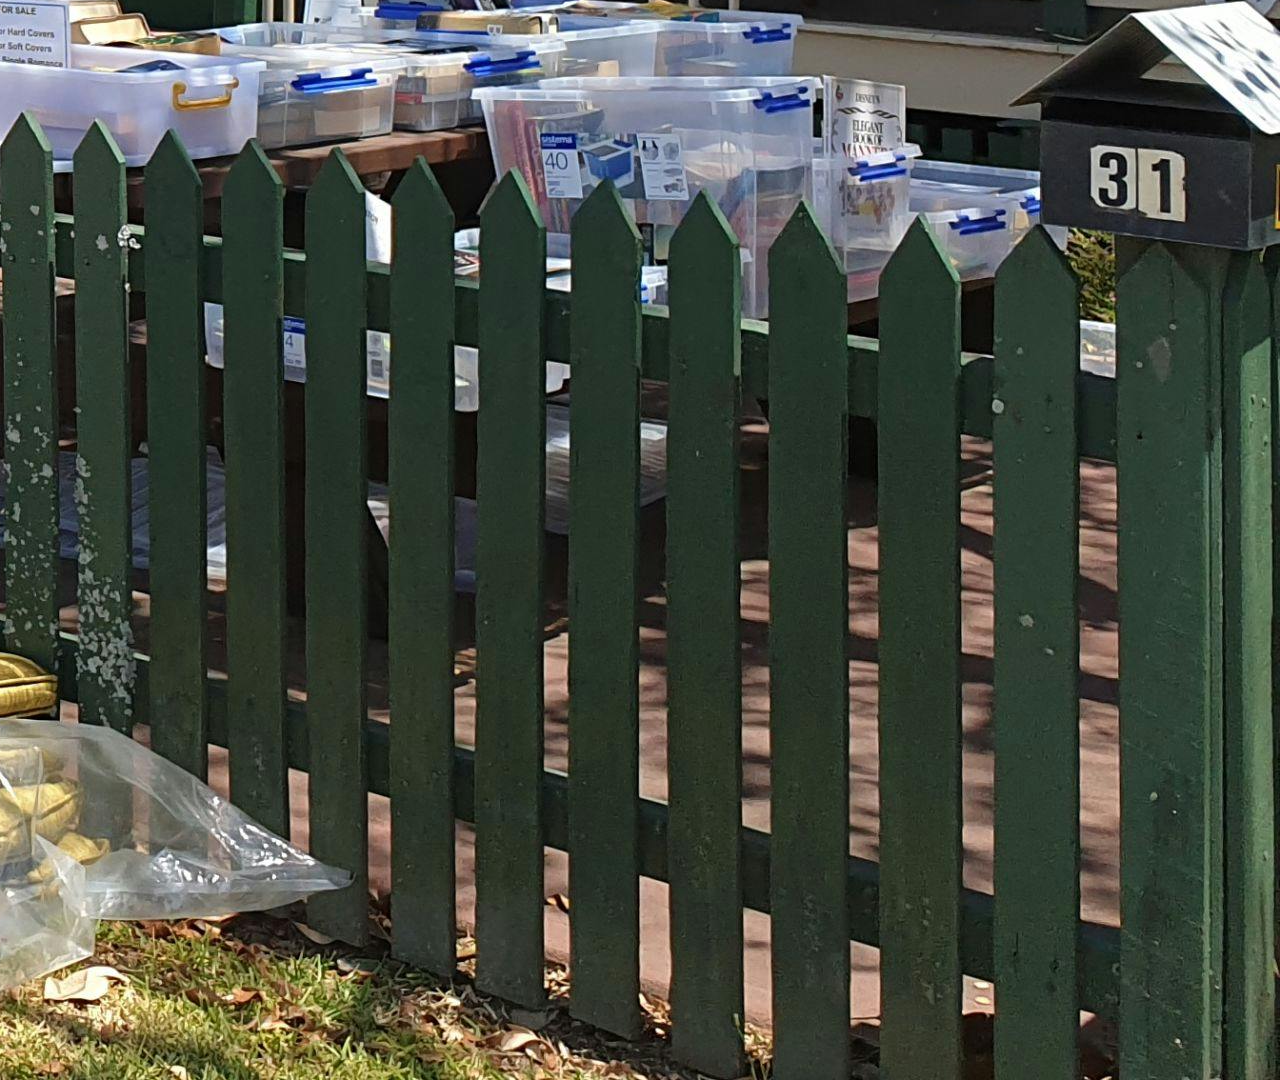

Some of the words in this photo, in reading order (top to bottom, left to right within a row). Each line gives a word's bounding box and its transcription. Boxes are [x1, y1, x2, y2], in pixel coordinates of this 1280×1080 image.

[15, 6, 37, 15] SALE
[7, 27, 26, 37] Hard
[28, 28, 55, 39] Covers
[8, 42, 23, 52] Soft
[25, 43, 52, 53] Covers
[852, 119, 885, 134] ELEGANT
[852, 132, 873, 145] BOOK
[874, 134, 884, 147] OF
[545, 151, 568, 171] 40
[1098, 151, 1172, 214] 31
